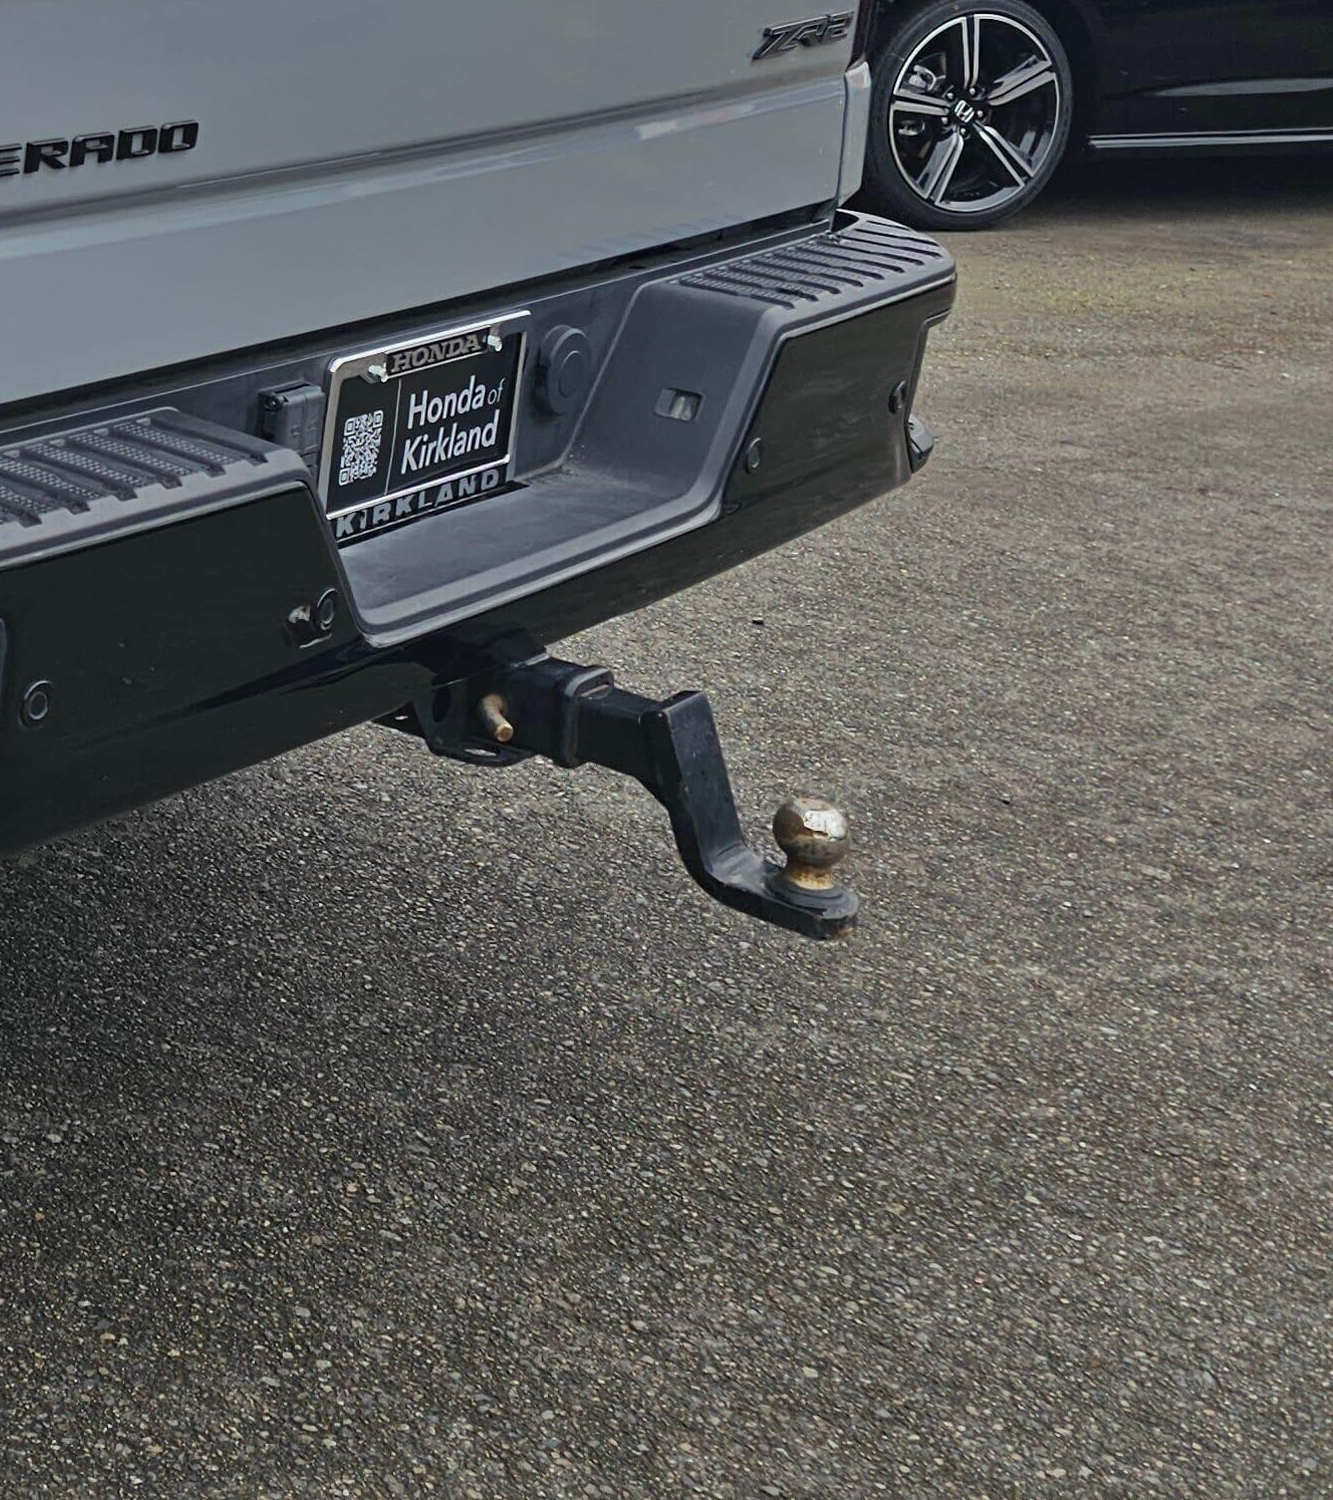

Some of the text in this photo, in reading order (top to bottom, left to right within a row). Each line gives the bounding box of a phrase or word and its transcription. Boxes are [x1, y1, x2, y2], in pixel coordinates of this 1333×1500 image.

[752, 10, 854, 61] ZR2
[390, 334, 482, 374] HONDA
[407, 375, 509, 430] Honda of
[400, 409, 501, 475] Kirkland
[336, 469, 499, 539] KIRKLAND
